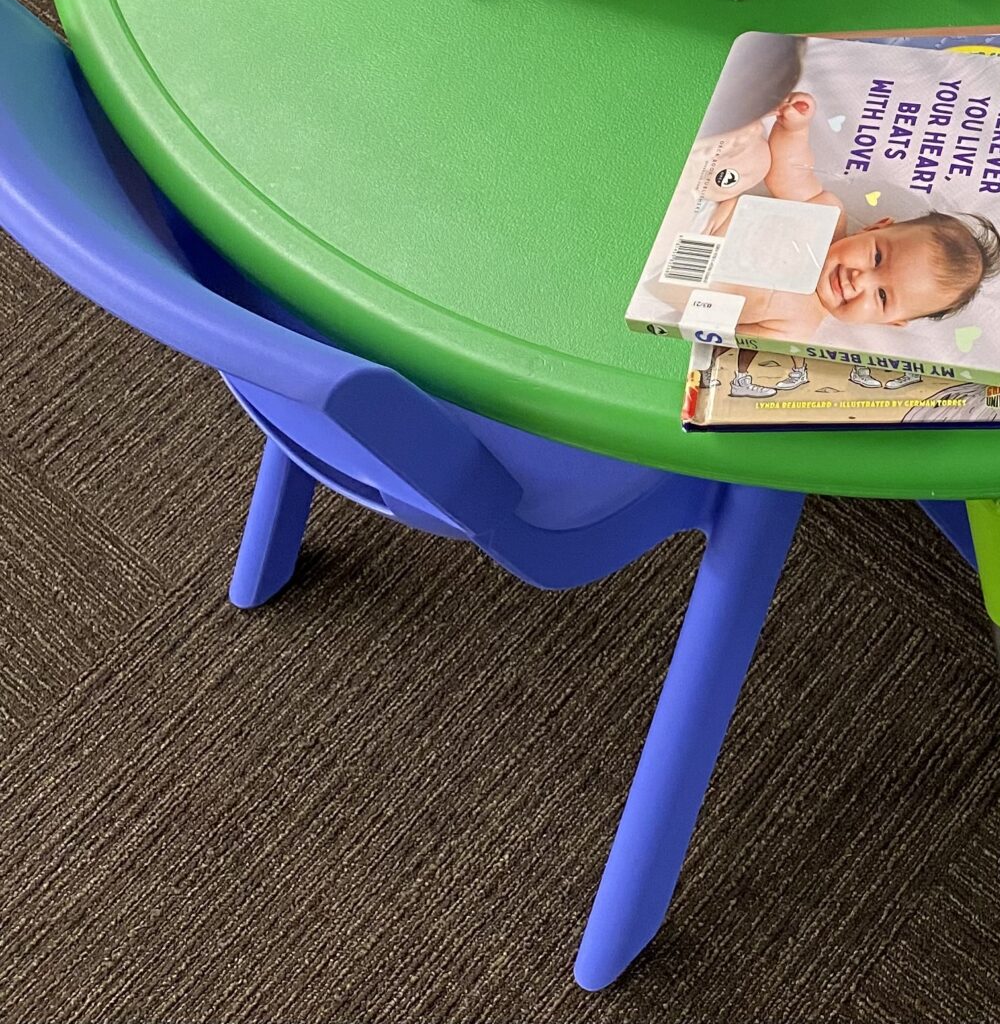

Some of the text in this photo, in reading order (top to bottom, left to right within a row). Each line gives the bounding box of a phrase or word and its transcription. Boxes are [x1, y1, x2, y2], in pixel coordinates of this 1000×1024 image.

[843, 79, 894, 175] WITH LOVE.
[884, 102, 921, 160] BEATS
[909, 80, 962, 194] YOUR HEART
[944, 96, 991, 181] YOU LIVE,
[806, 347, 955, 378] MY HEART BEATS
[755, 399, 967, 410] LYNDA BEAUREGARD ILLUSTRATED BY GERMAN TORRES
